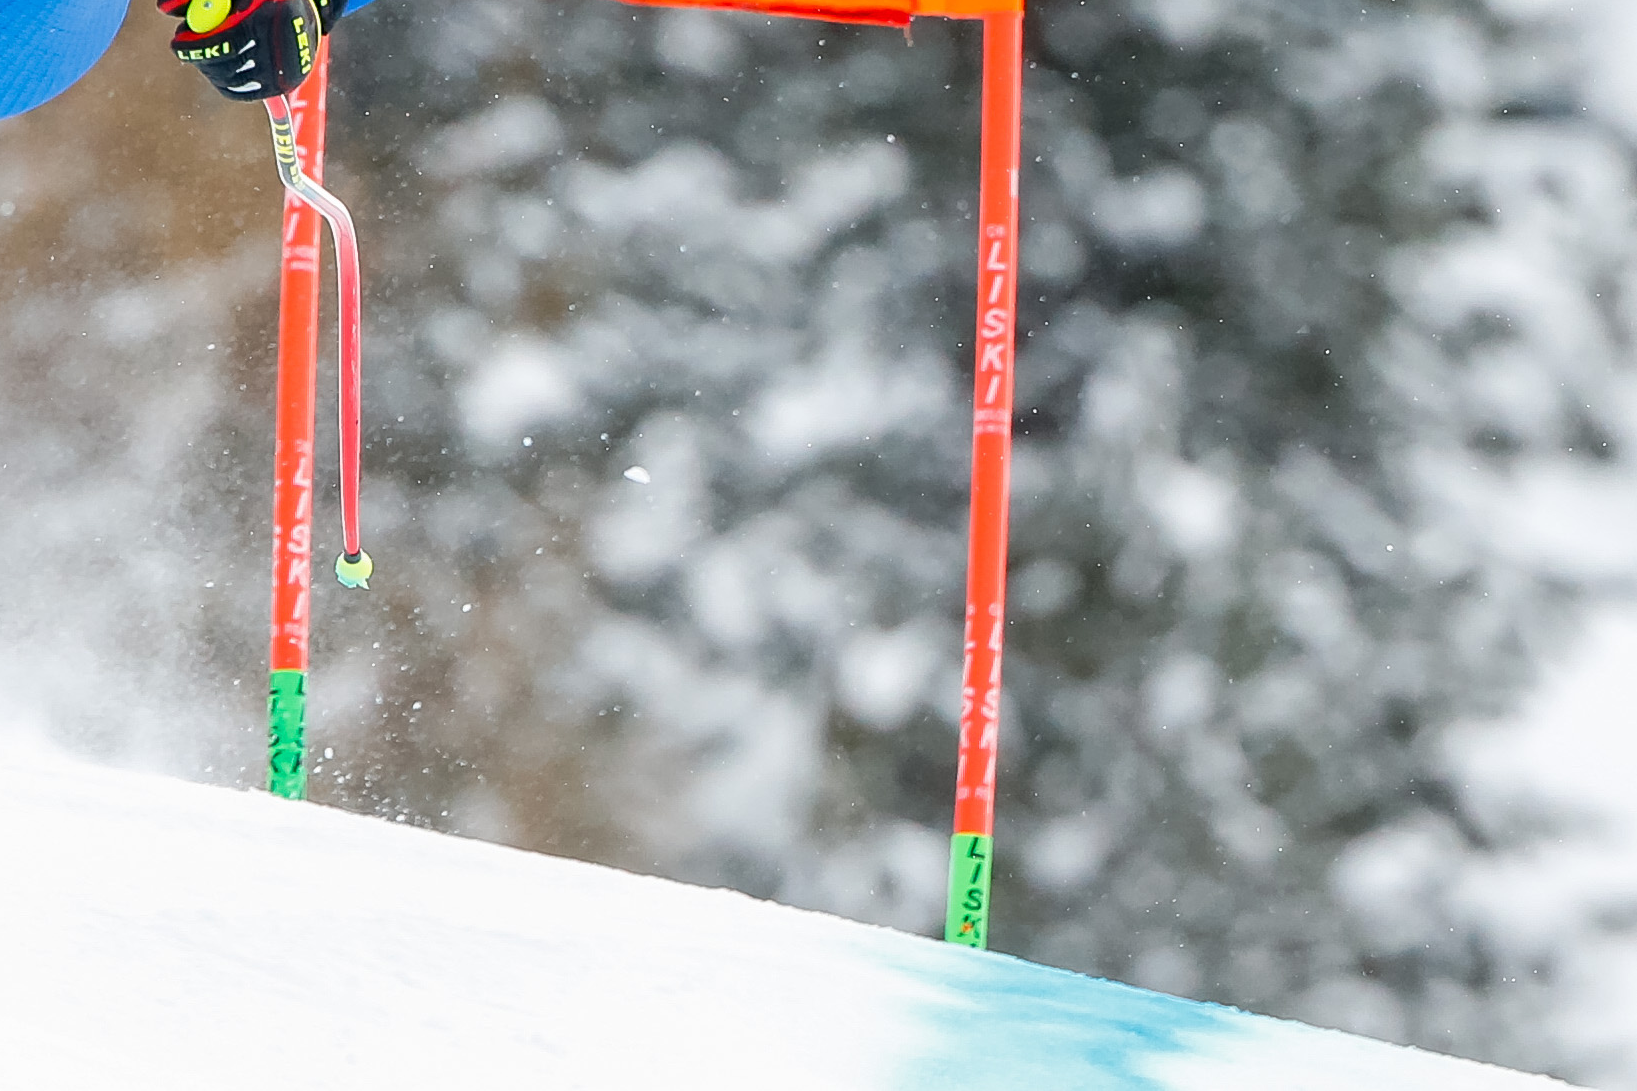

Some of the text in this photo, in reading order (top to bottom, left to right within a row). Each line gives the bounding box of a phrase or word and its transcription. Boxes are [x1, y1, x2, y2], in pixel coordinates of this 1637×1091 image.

[177, 41, 230, 60] LEKI
[292, 17, 312, 75] LEKI
[980, 240, 1007, 404] LISKI
[957, 837, 986, 947] LISK
